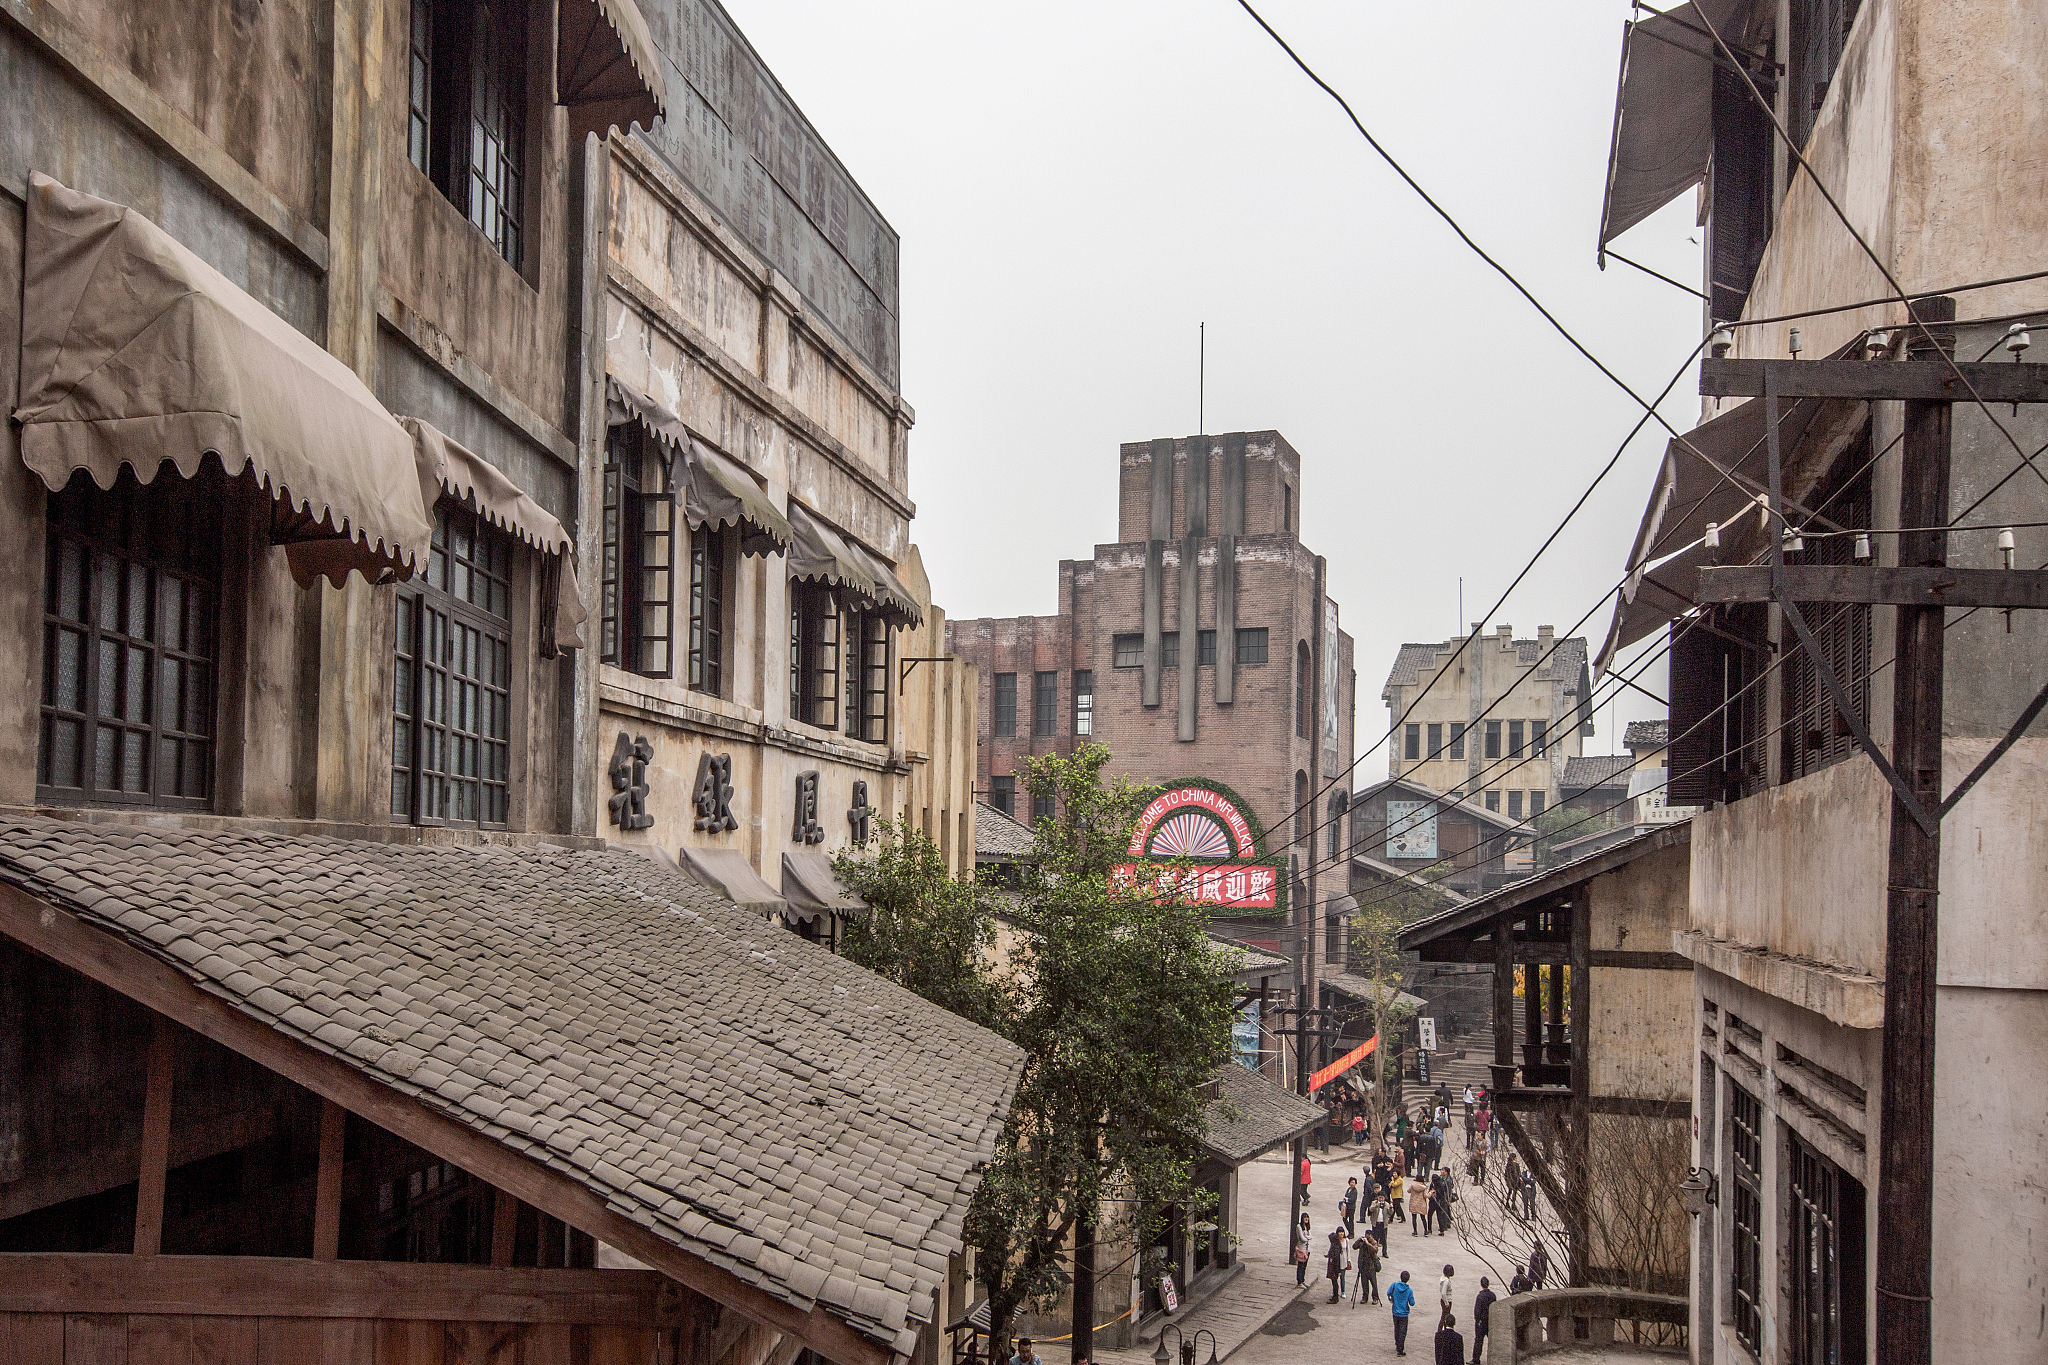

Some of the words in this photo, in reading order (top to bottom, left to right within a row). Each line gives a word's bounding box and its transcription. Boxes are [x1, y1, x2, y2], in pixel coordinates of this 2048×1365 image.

[1130, 801, 1165, 851] WELCOME
[1162, 792, 1179, 807] TO
[1181, 789, 1214, 806] CHINA
